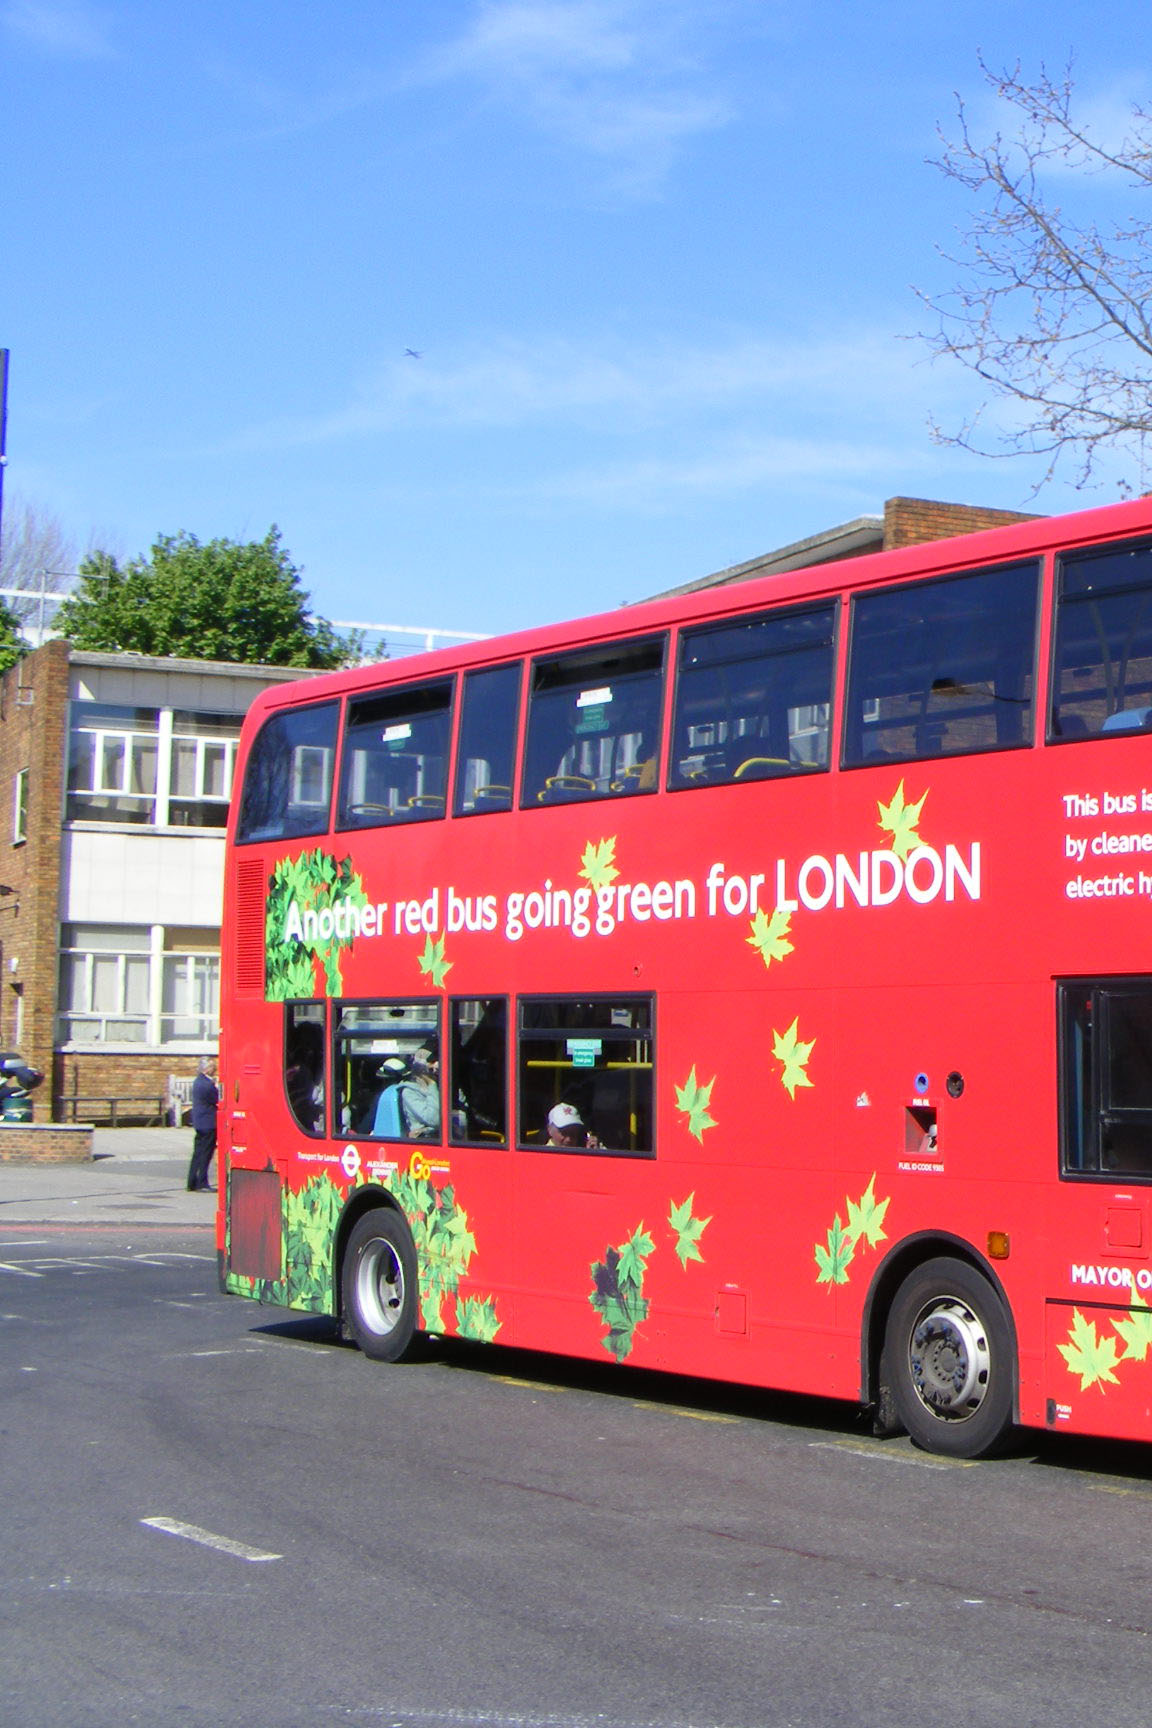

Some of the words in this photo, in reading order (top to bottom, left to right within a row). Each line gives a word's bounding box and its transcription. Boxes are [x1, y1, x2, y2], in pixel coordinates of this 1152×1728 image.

[1063, 794, 1100, 818] This
[1103, 791, 1138, 815] bus
[1065, 834, 1088, 860] by
[283, 897, 388, 944] Another
[395, 887, 439, 937] red
[447, 886, 498, 929] bus
[506, 878, 593, 942] going
[597, 877, 696, 938] green
[706, 862, 765, 917] for
[775, 841, 981, 914] LONDON
[1066, 872, 1135, 899] electric
[410, 1151, 431, 1180] Go
[1071, 1264, 1133, 1289] MAYOR
